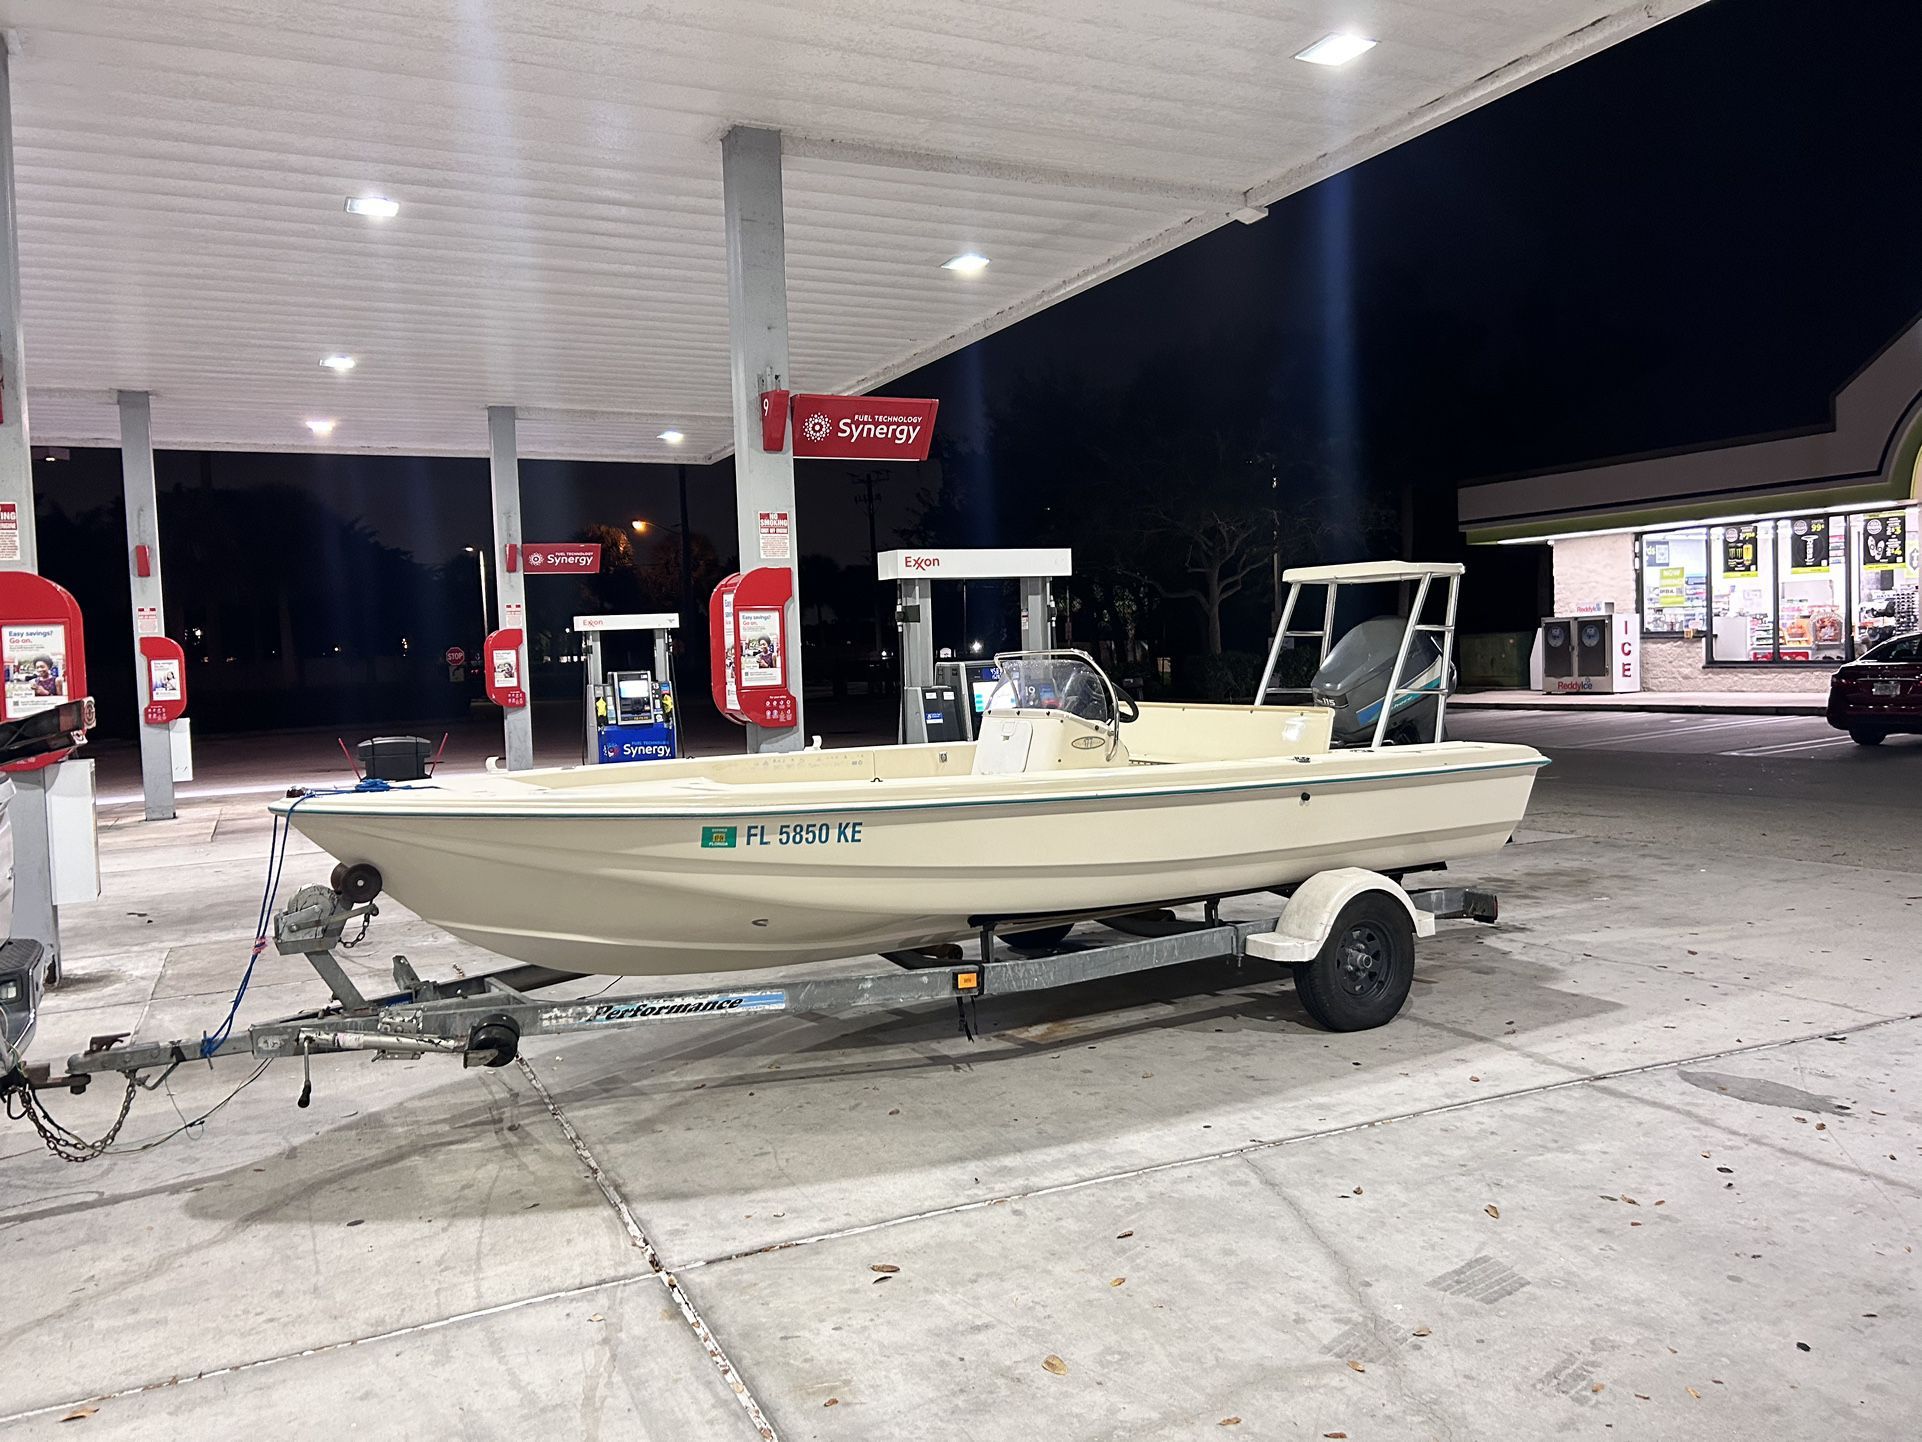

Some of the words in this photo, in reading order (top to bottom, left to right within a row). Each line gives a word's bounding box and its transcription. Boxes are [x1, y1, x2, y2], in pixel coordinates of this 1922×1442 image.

[763, 398, 769, 416] 9
[874, 415, 922, 423] TECHNOLOGY
[838, 419, 921, 444] Synergy
[547, 554, 593, 566] Synergy
[904, 556, 940, 571] Exxon
[583, 619, 604, 628] Exxon
[26, 630, 53, 638] savings?
[1621, 620, 1632, 678] ICE
[1025, 686, 1036, 697] 19
[623, 744, 671, 758] Synergy
[746, 825, 771, 846] FL
[778, 823, 830, 845] 5850
[837, 822, 863, 843] KE
[586, 997, 744, 1023] Performance
